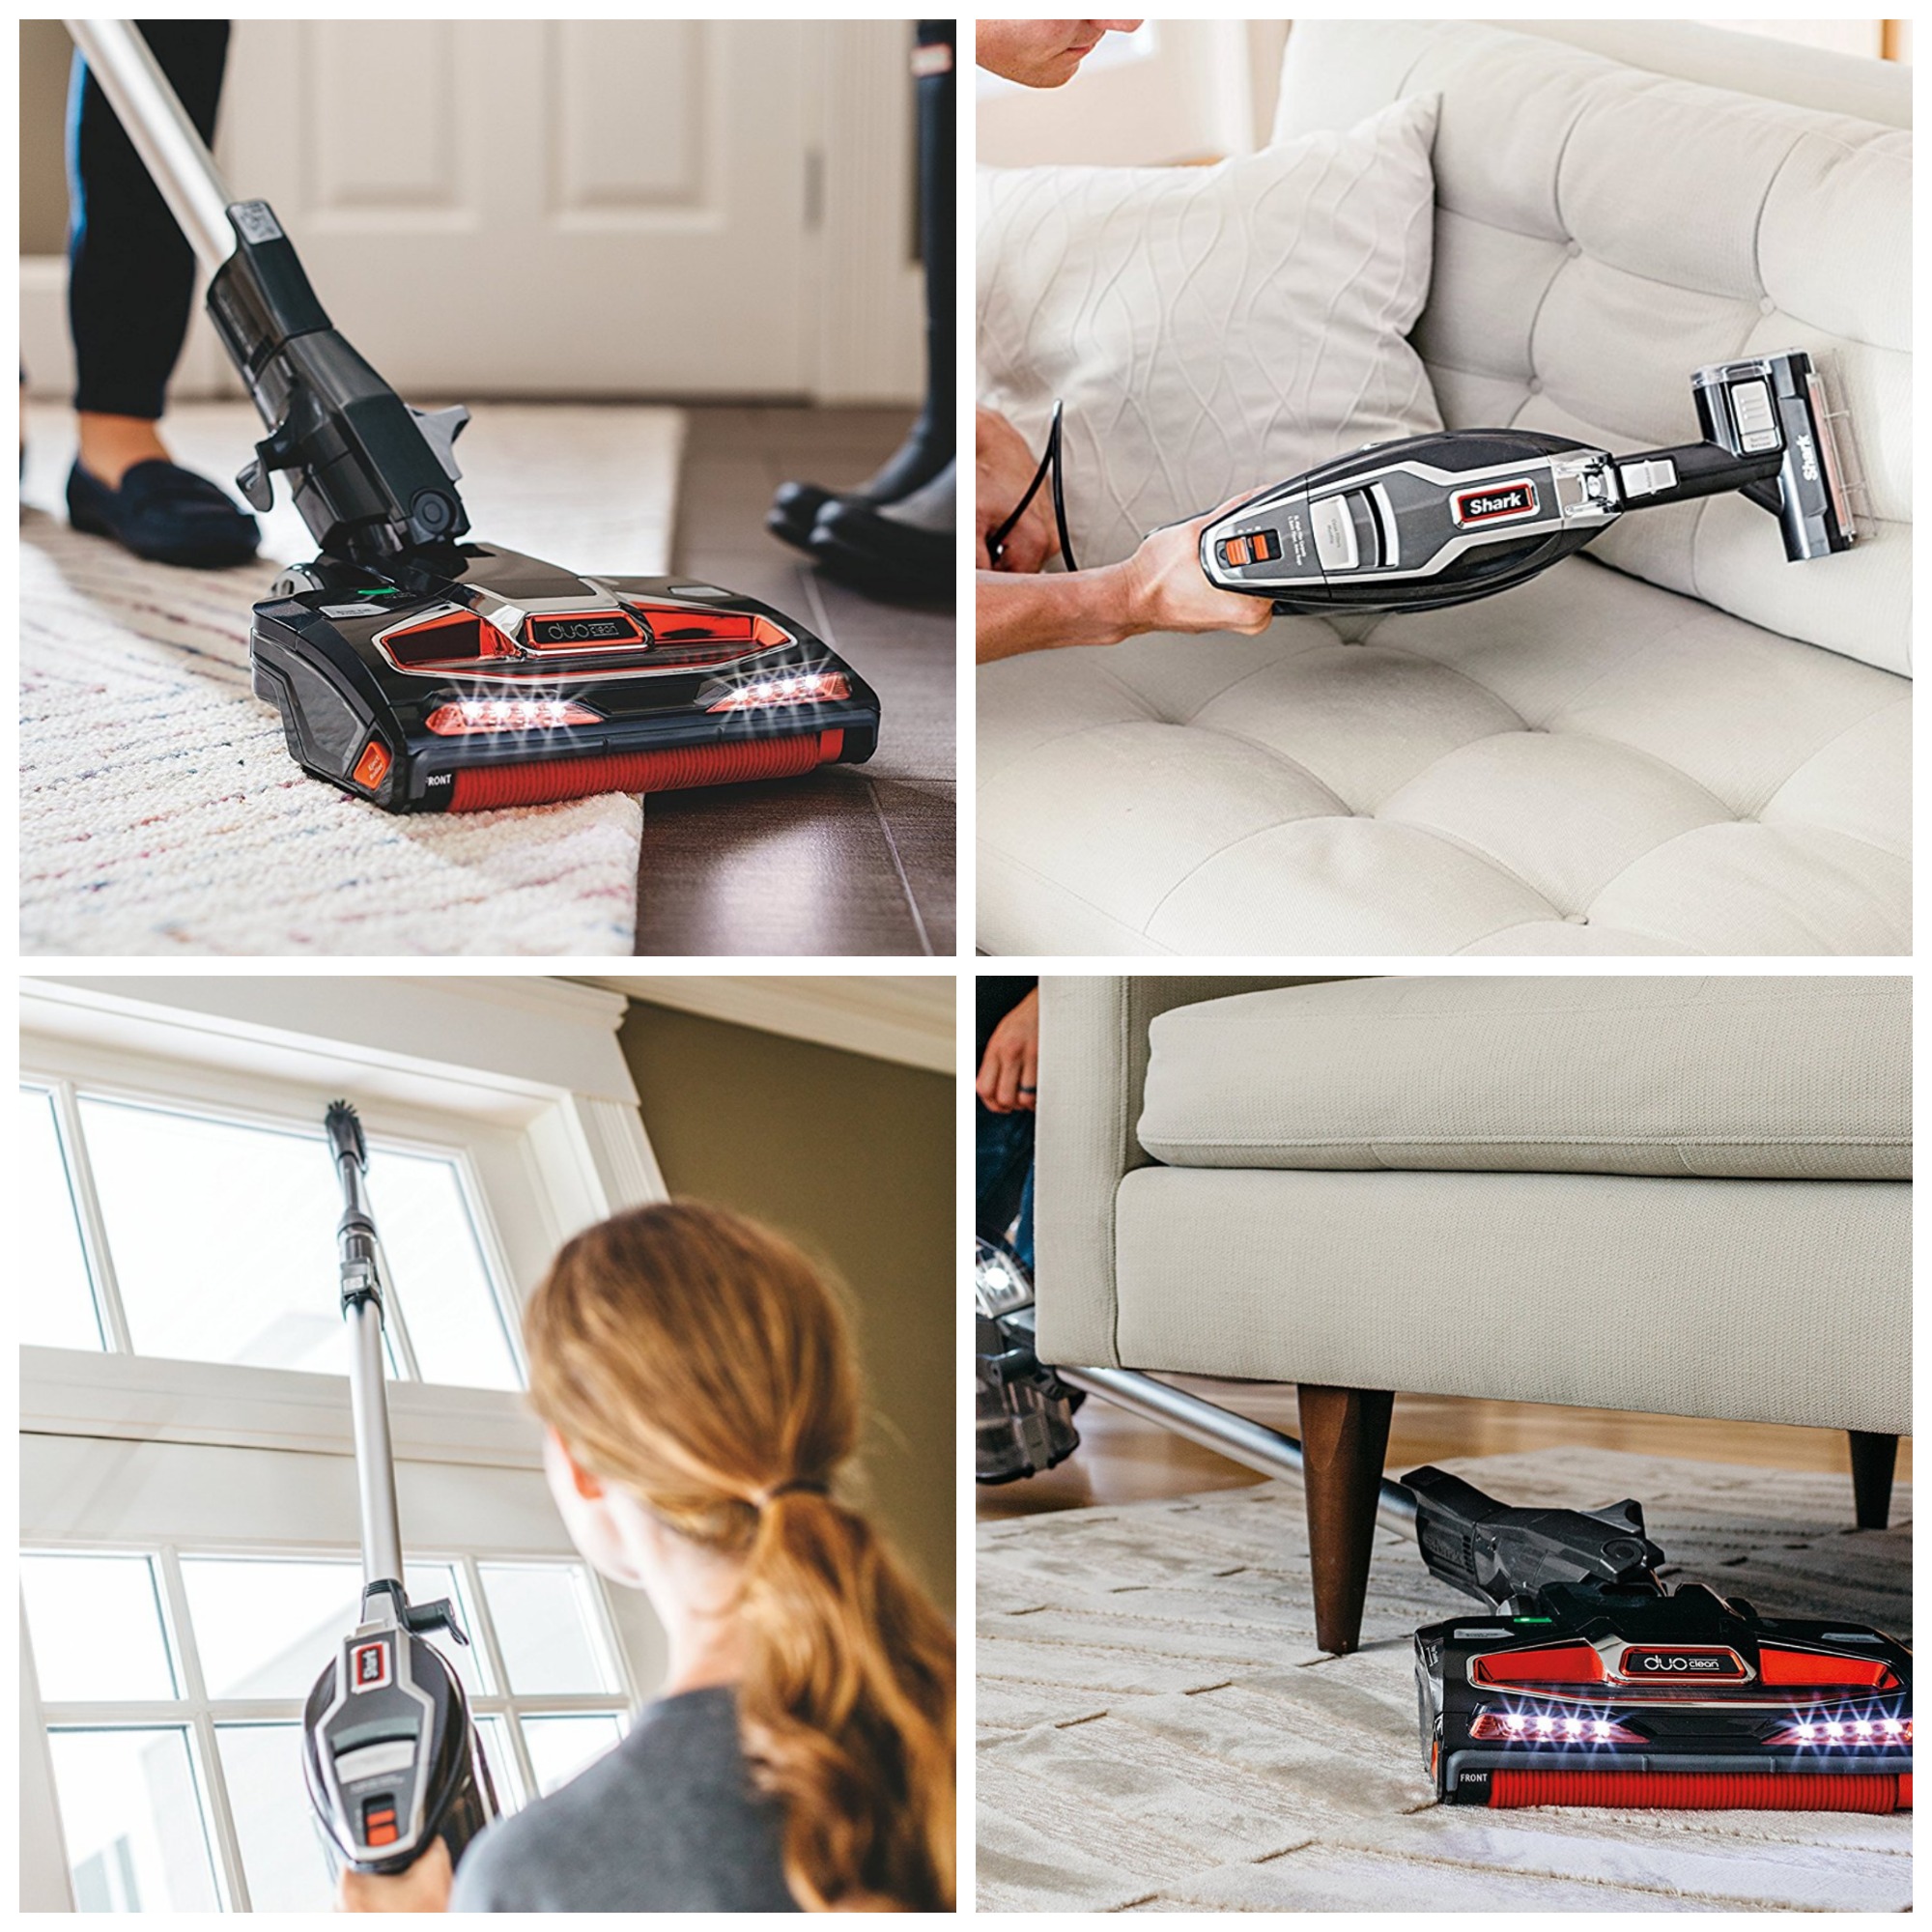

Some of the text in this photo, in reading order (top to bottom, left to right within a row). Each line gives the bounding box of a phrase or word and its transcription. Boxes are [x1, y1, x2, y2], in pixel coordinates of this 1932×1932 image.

[1796, 435, 1819, 481] Shark
[1469, 492, 1521, 515] Shark
[548, 623, 590, 639] duo
[1643, 1655, 1720, 1671] duo clean
[1460, 1773, 1488, 1782] FRONT
